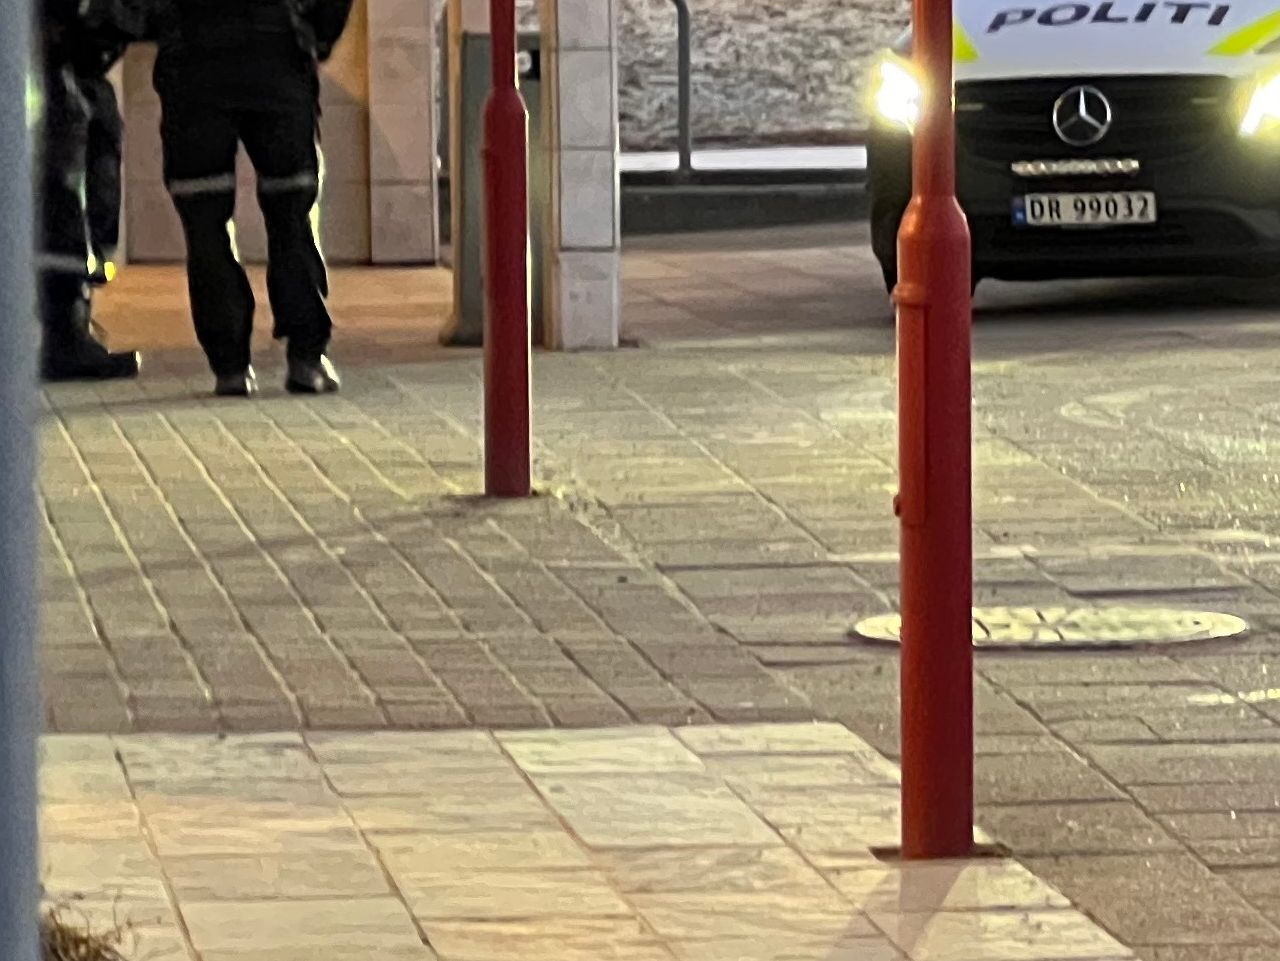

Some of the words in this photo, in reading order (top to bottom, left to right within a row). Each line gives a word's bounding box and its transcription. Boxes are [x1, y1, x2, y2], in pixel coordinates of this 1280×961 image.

[986, 1, 1231, 33] POLITI
[1030, 197, 1061, 221] DR
[1073, 194, 1149, 220] 99032
